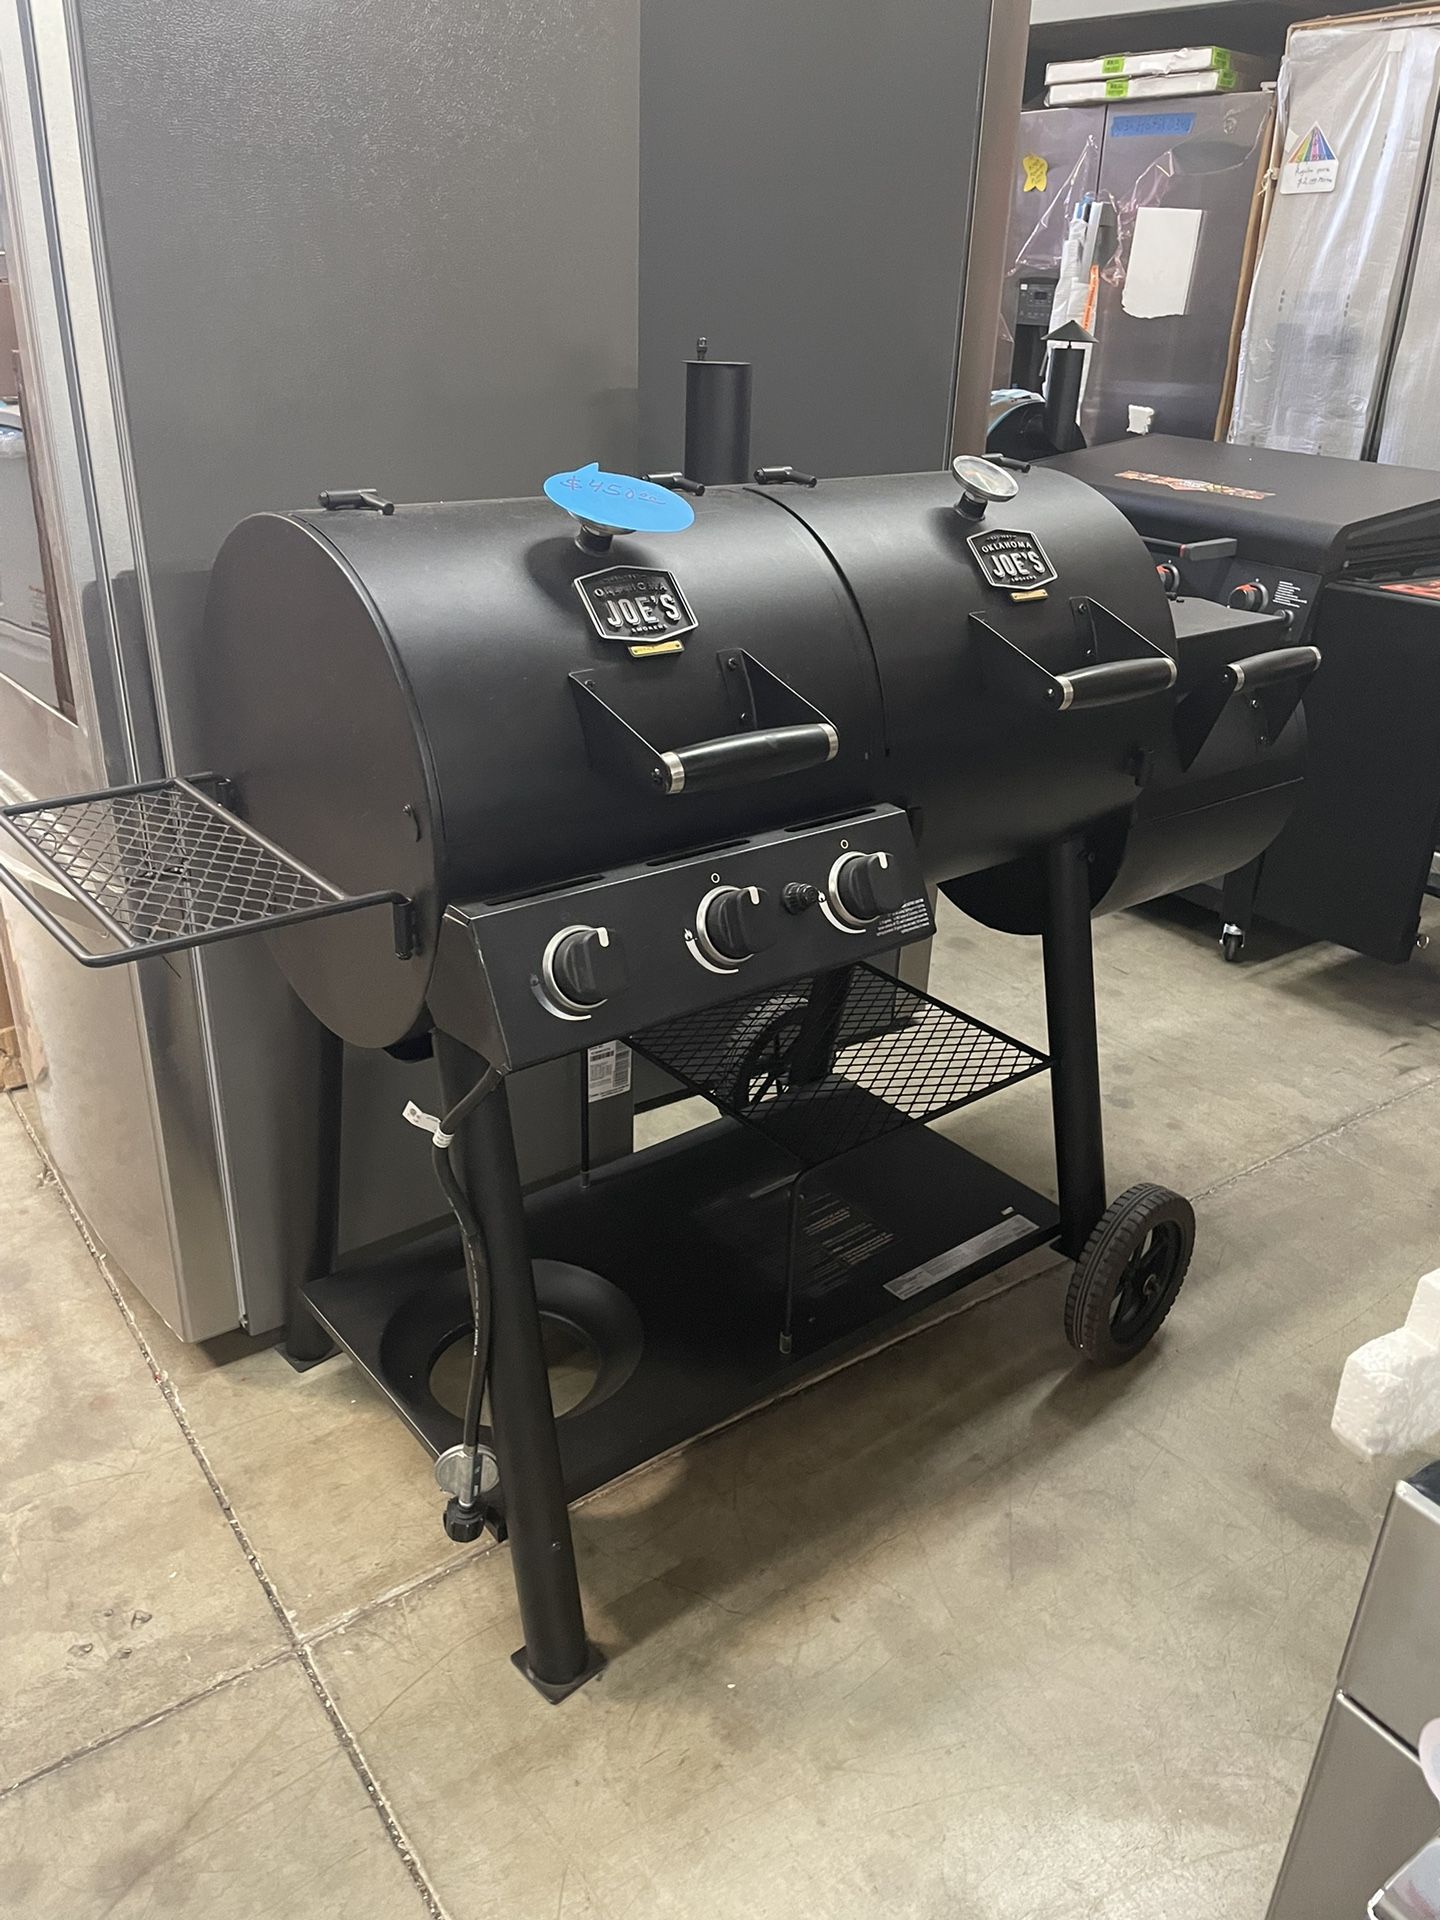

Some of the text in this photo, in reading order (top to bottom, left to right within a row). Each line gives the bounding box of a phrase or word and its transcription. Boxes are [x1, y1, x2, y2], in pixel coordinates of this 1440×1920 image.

[981, 541, 1033, 553] OKLAHOMA
[991, 551, 1046, 578] JOE'S
[606, 593, 682, 627] JOE'S
